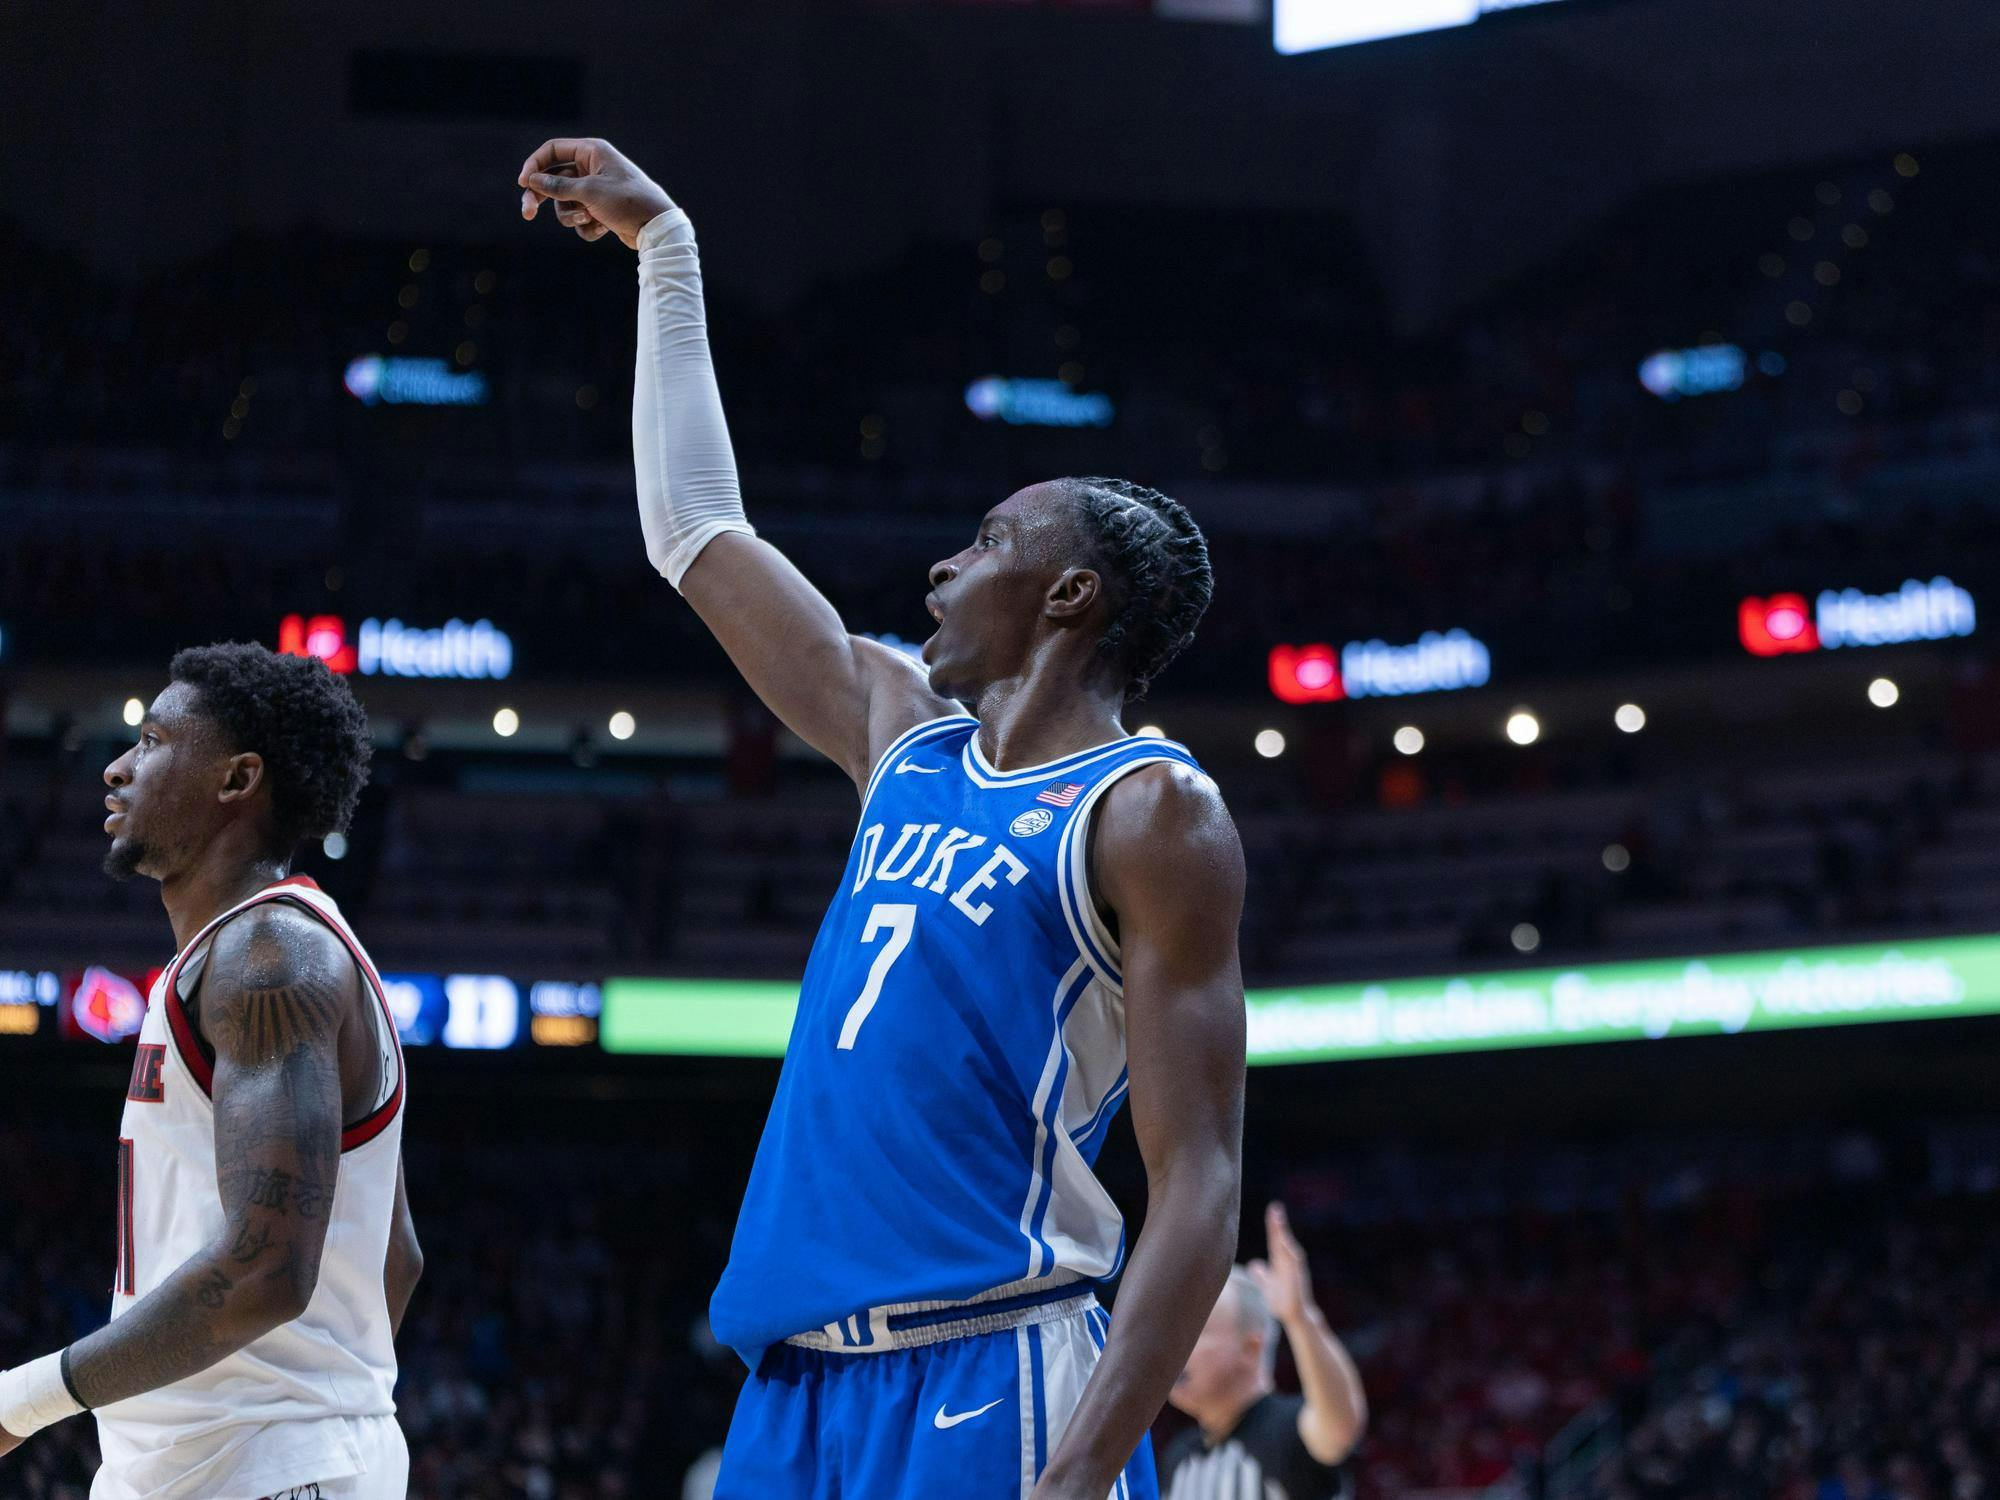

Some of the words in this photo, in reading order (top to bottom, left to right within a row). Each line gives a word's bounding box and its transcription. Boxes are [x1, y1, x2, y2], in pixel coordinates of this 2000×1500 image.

[358, 617, 513, 680] Health
[1818, 576, 1975, 650] Health
[1341, 628, 1491, 699] Health
[852, 823, 1030, 927] DUKE
[836, 903, 917, 1050] 7
